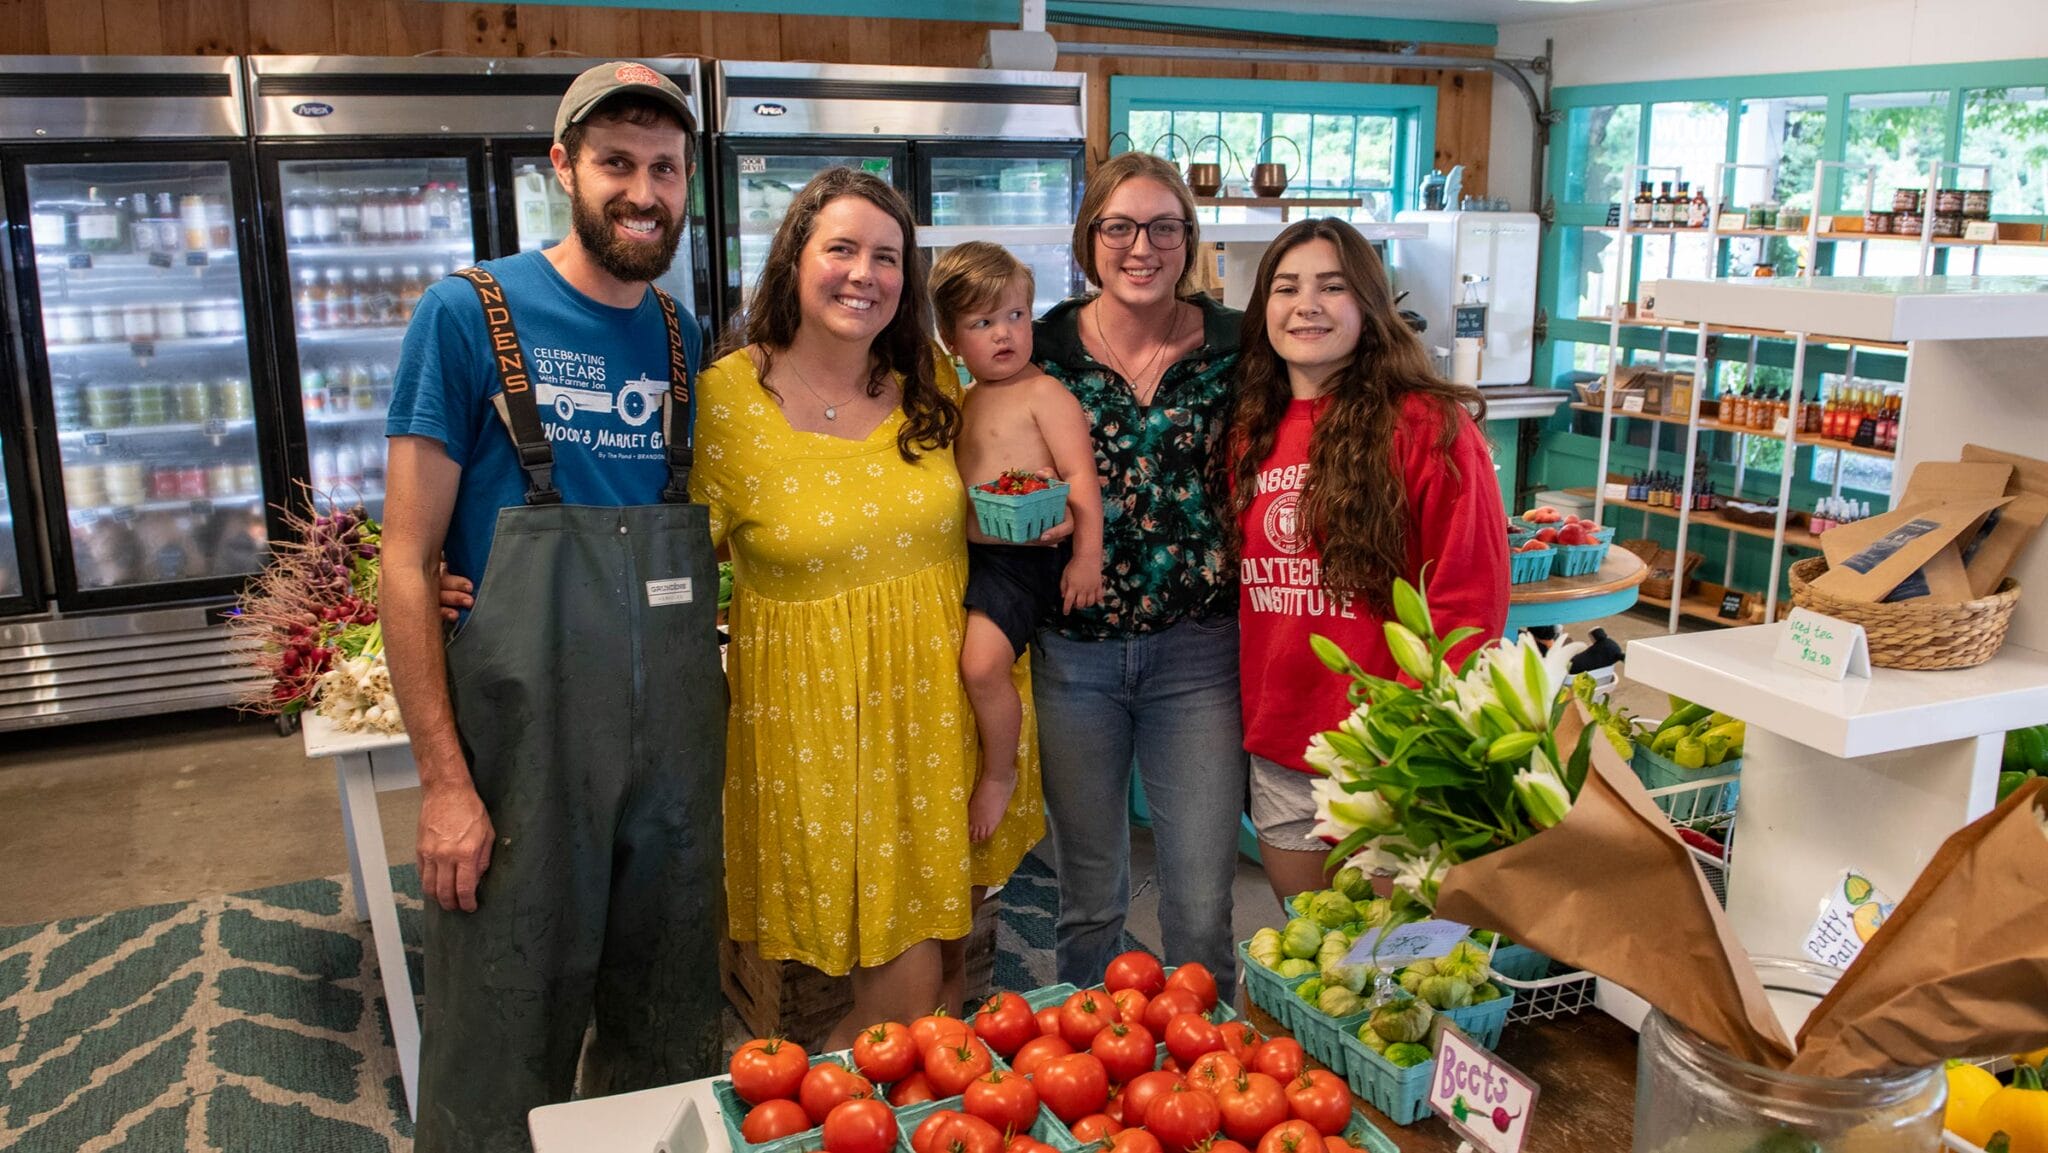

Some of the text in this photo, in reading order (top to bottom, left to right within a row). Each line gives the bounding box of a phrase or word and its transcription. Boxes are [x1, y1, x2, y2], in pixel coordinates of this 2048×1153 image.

[533, 347, 605, 366] CELEBRATING
[536, 359, 606, 381] 20 YEARS
[559, 375, 589, 389] Farmer
[592, 381, 606, 390] Jon
[592, 429, 647, 451] MARKET
[1254, 463, 1316, 497] NSSE
[1249, 586, 1357, 619] INSTITUTE
[1815, 625, 1834, 640] tea
[1440, 1045, 1508, 1104] Beets
